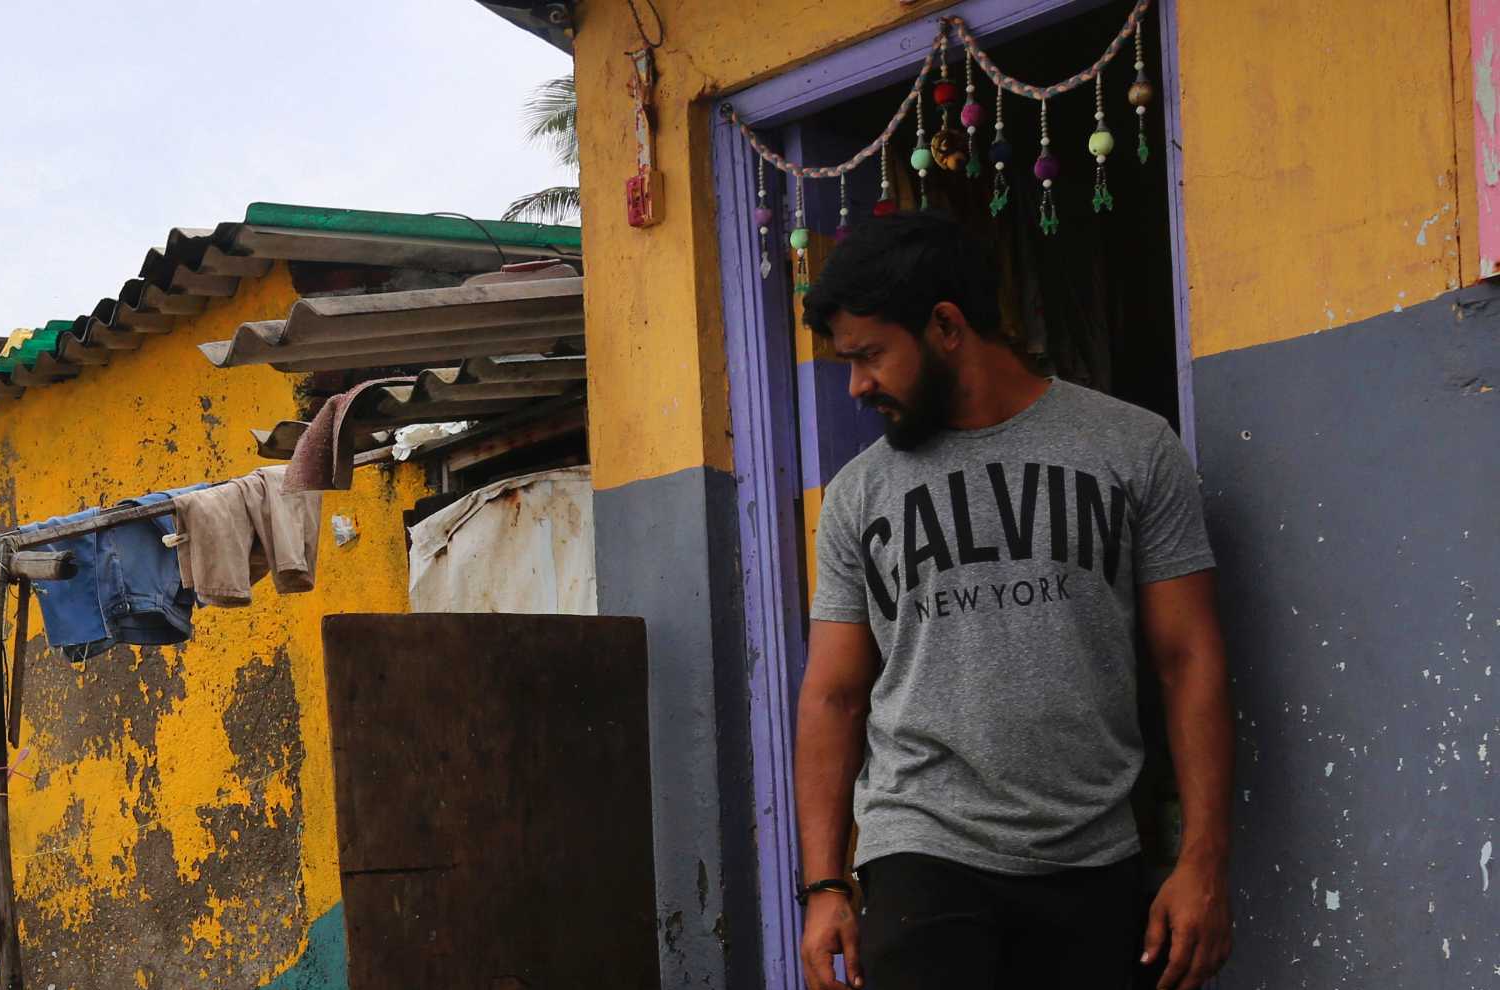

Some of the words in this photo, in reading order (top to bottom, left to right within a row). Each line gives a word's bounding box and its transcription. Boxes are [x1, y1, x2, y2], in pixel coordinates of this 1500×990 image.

[862, 462, 1127, 622] CALVIN
[915, 586, 981, 623] NEW
[991, 573, 1071, 609] YORK
